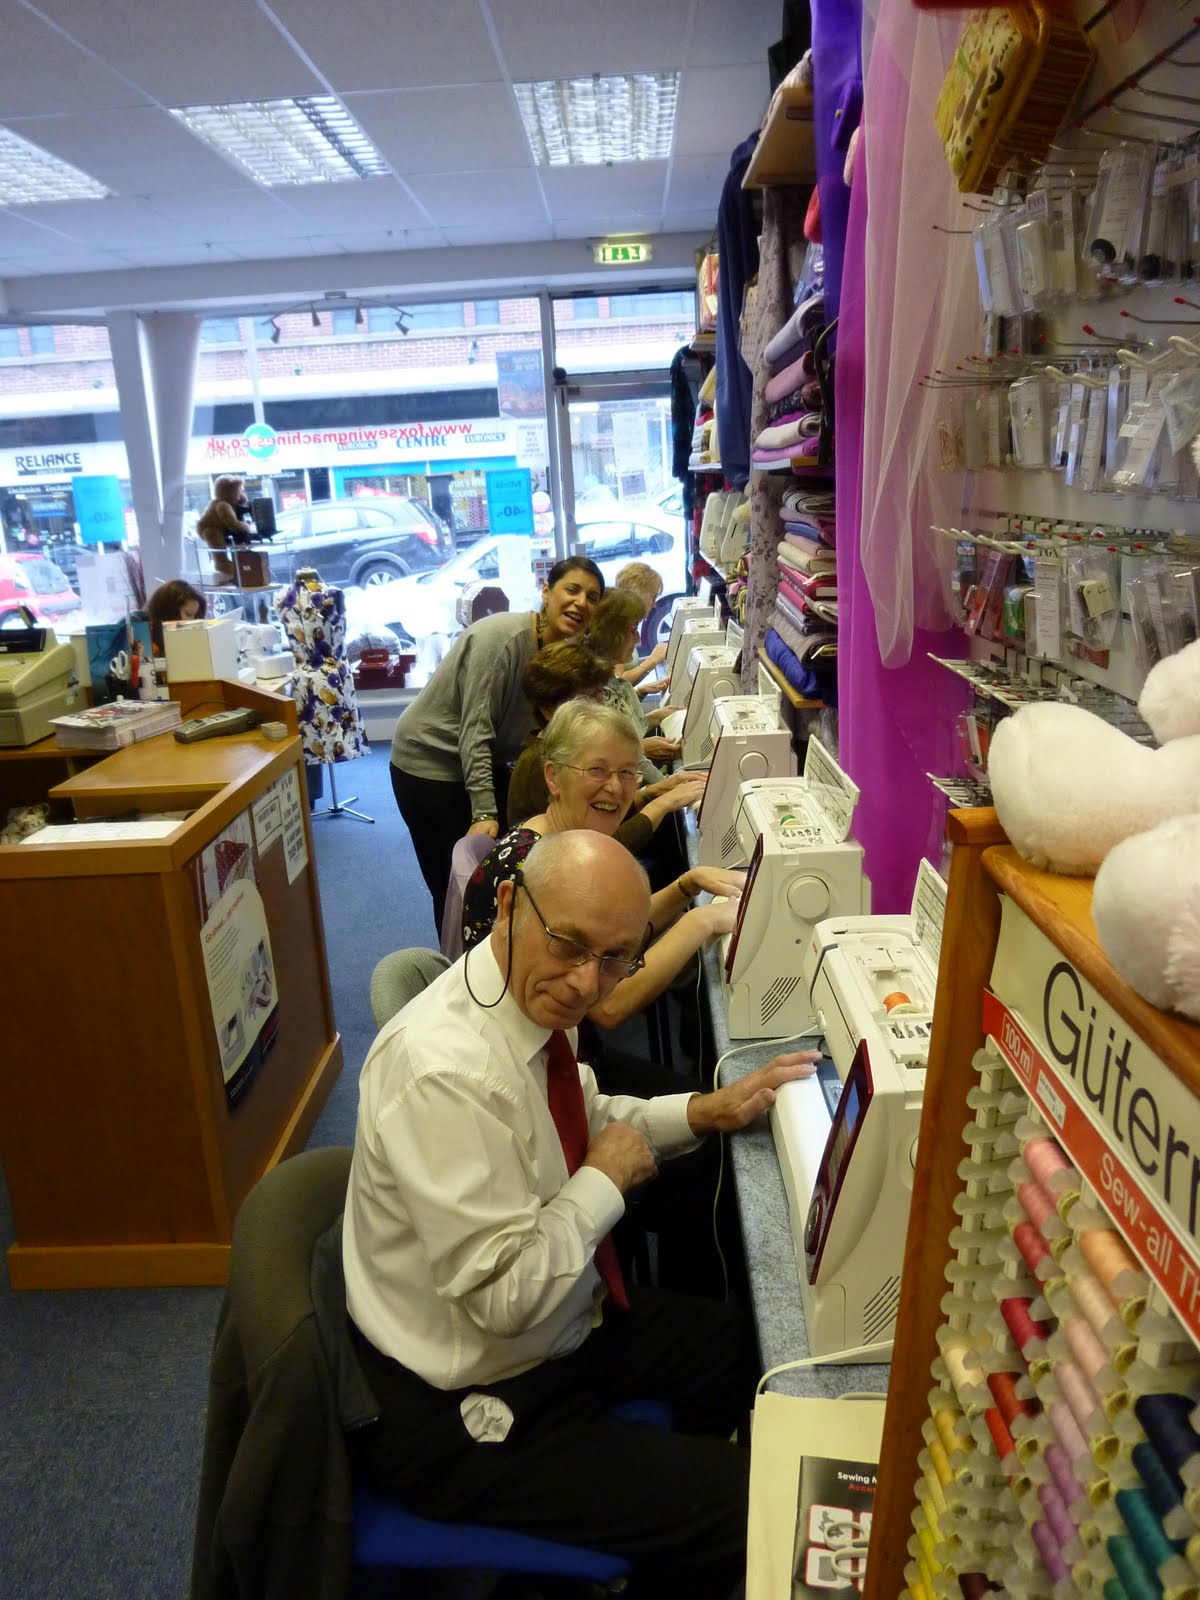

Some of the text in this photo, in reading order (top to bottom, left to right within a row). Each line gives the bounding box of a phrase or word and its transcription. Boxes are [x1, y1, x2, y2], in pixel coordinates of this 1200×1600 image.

[396, 435, 449, 448] CENTRE
[465, 432, 505, 443] EURONICS
[15, 453, 81, 472] RELIANCE
[1099, 1152, 1173, 1275] Sew-all
[837, 1472, 870, 1485] Sewing
